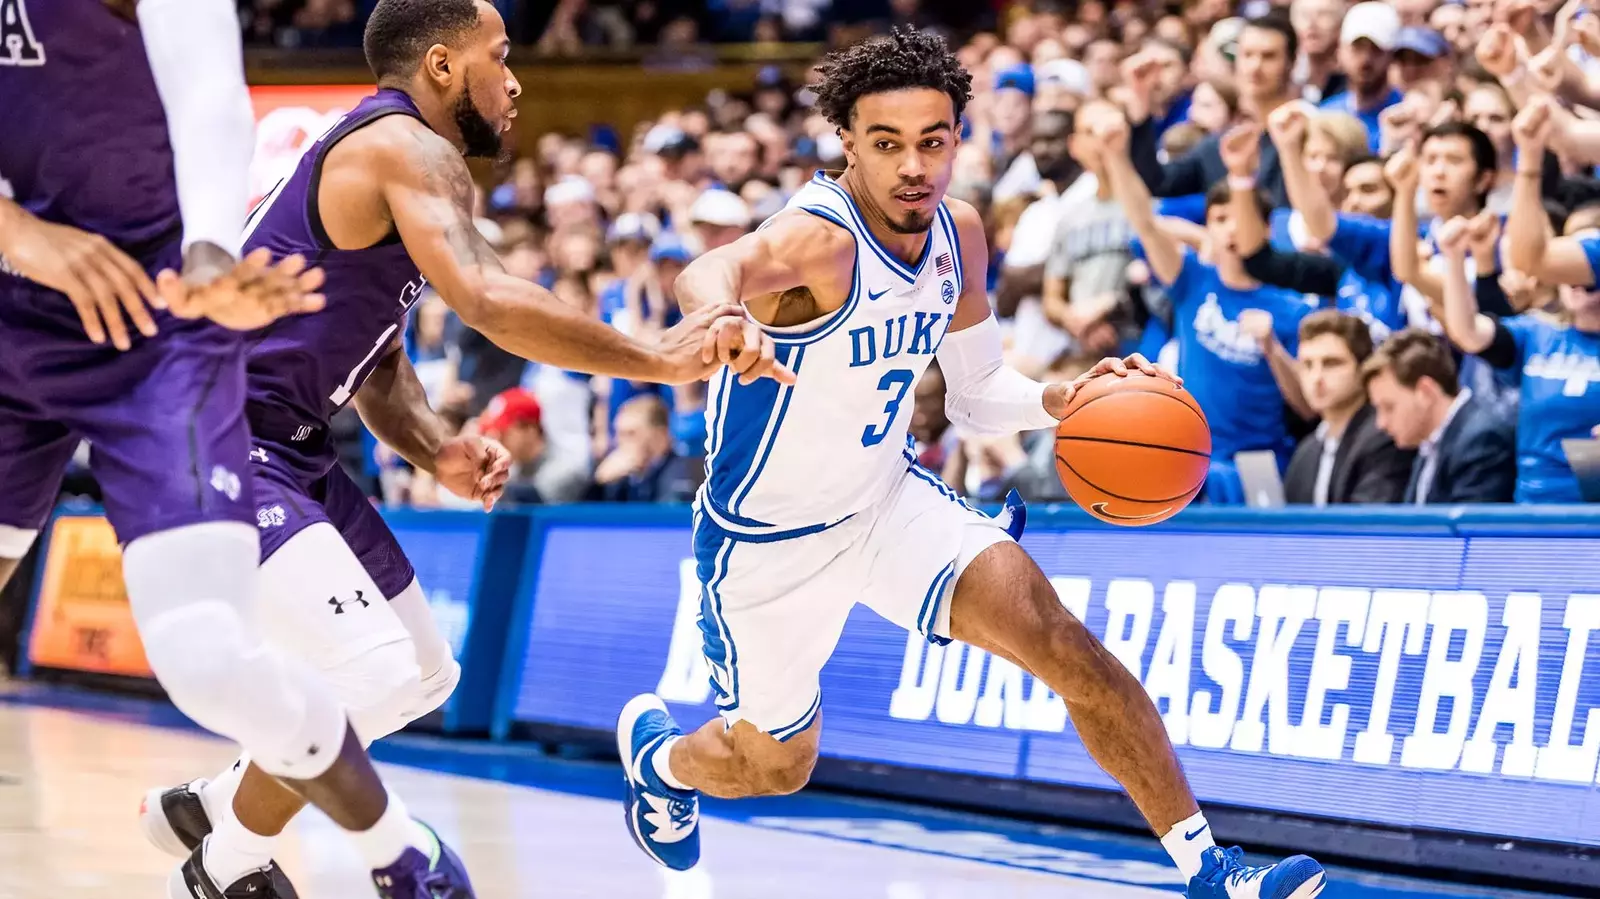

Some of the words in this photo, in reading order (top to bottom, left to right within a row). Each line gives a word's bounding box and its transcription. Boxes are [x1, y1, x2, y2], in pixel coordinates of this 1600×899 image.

[849, 312, 954, 367] DUK
[861, 369, 914, 447] 3
[1103, 578, 1600, 784] BASKETBAL
